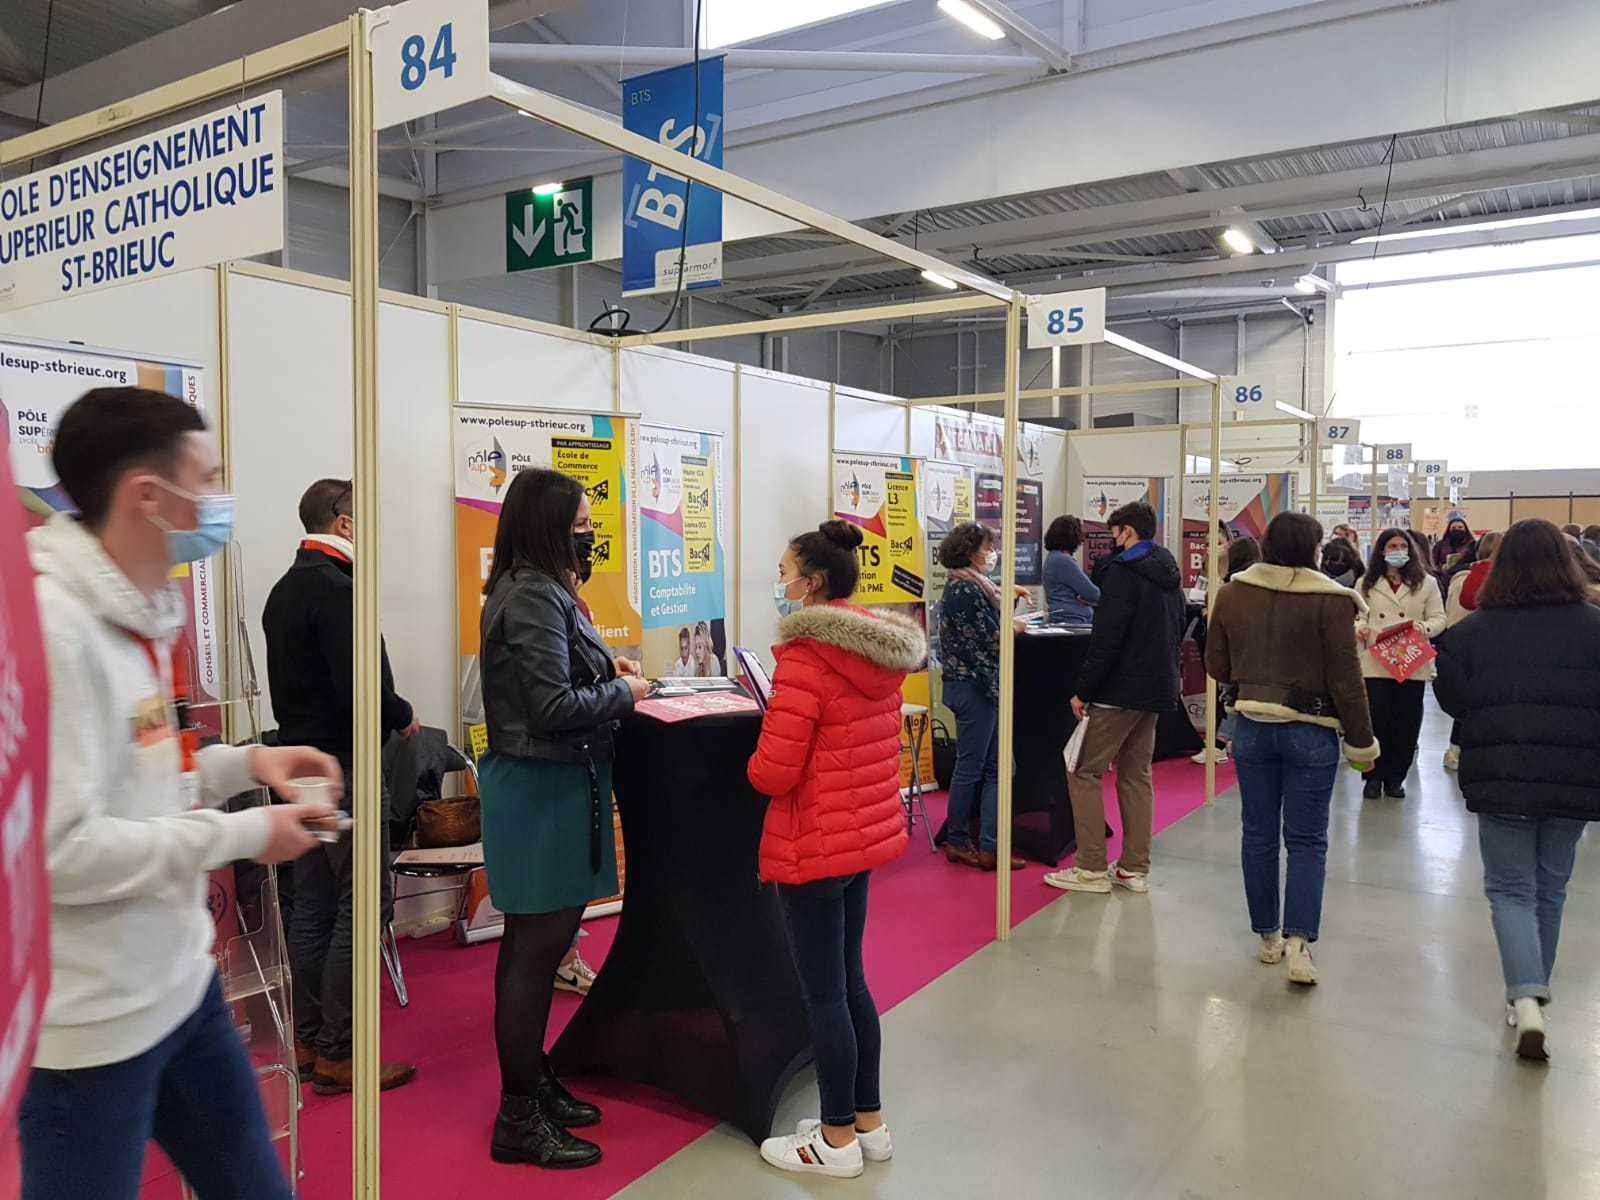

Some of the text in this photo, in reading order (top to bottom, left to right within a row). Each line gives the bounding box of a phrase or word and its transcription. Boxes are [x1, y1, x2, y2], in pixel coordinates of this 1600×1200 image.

[401, 22, 457, 90] 84
[631, 89, 651, 105] BTS
[1, 104, 265, 220] OLE D'ENSEIGNEMENT
[0, 153, 273, 264] UPERIEUR CATHOLIQUE
[62, 231, 175, 291] ST-BRIEUC
[1047, 307, 1083, 334] 85
[0, 352, 127, 383] lesup-stbrieuc.org
[1236, 385, 1262, 403] 86
[18, 409, 47, 422] PÔLE
[460, 416, 586, 433] www.polesup-stbrieuc.org
[1328, 426, 1349, 439] 87
[1386, 449, 1404, 460] 88
[1426, 464, 1440, 474] 89
[1450, 476, 1463, 484] 90
[887, 492, 898, 504] L3
[648, 548, 682, 578] BTS
[856, 545, 881, 567] TS
[860, 572, 876, 580] tion
[867, 583, 884, 593] PME
[650, 602, 689, 617] et Gestion
[199, 559, 213, 684] CONSEIL ET COMMERCIAL
[593, 624, 630, 638] lient
